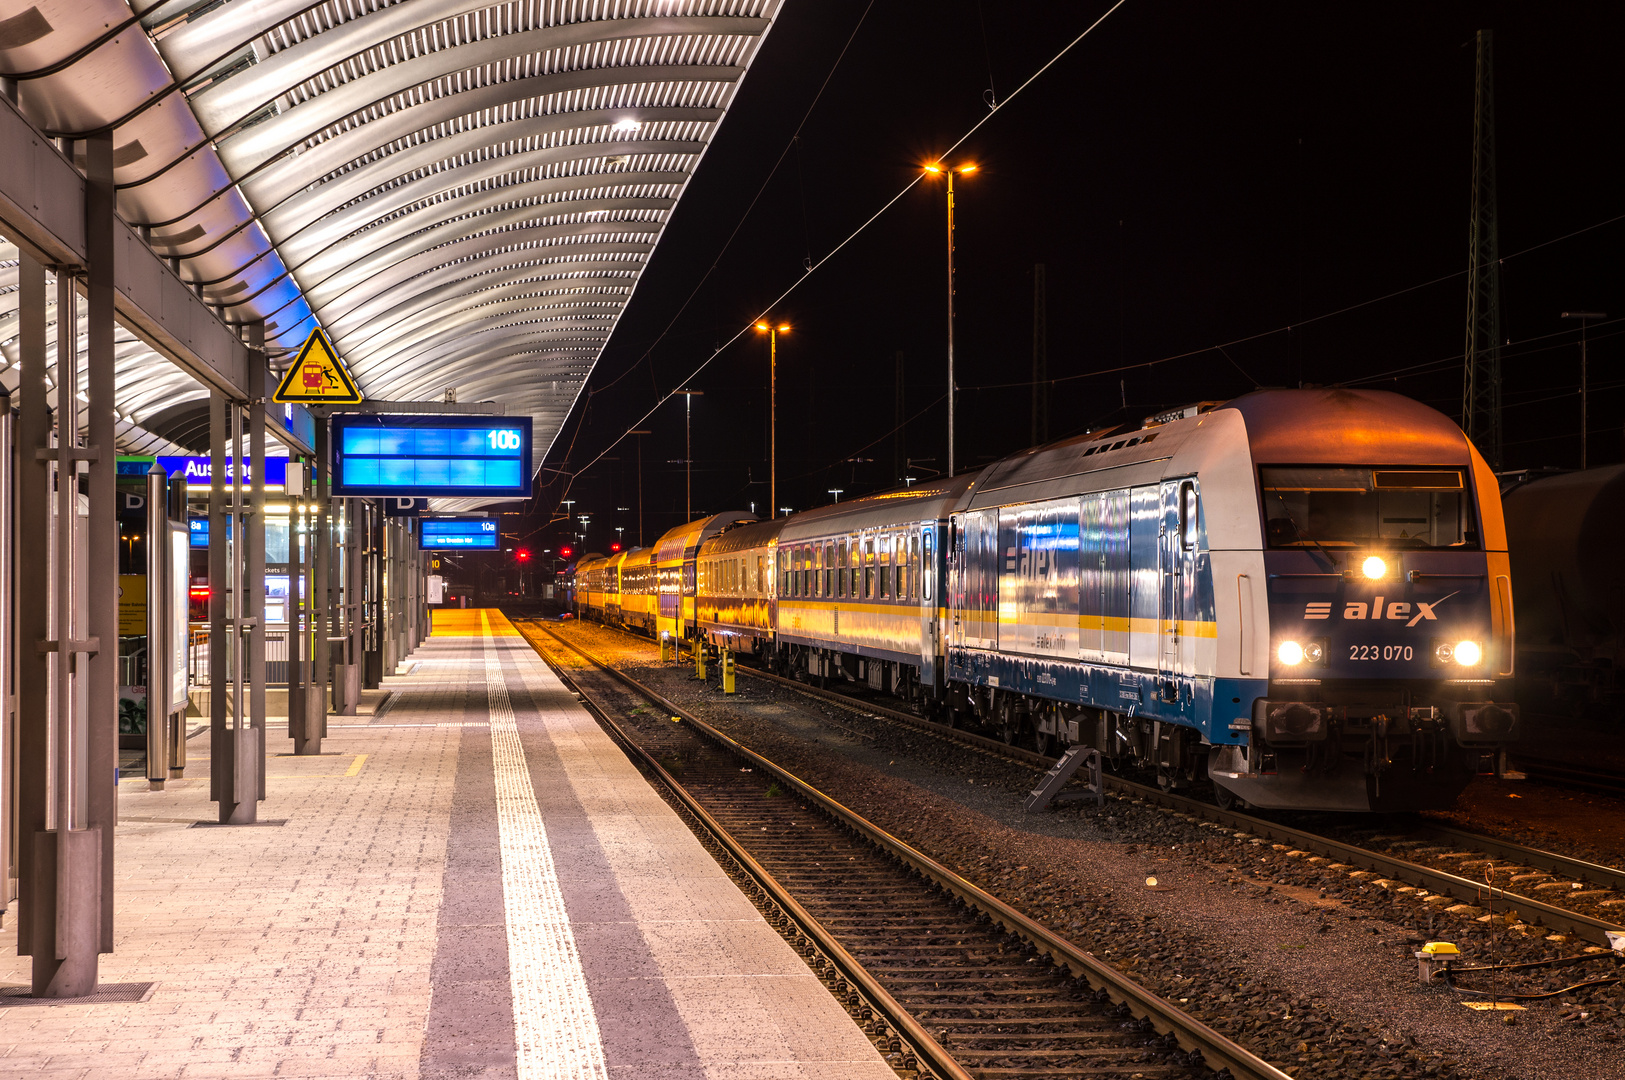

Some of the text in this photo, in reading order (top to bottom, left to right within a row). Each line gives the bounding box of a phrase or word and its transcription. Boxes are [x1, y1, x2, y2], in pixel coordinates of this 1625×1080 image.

[488, 430, 520, 449] 10b
[185, 460, 252, 480] Ausang
[481, 522, 495, 531] 10a
[432, 560, 440, 568] 10
[1020, 541, 1058, 585] alex
[1343, 590, 1461, 628] alex
[1350, 645, 1414, 661] 223 070
